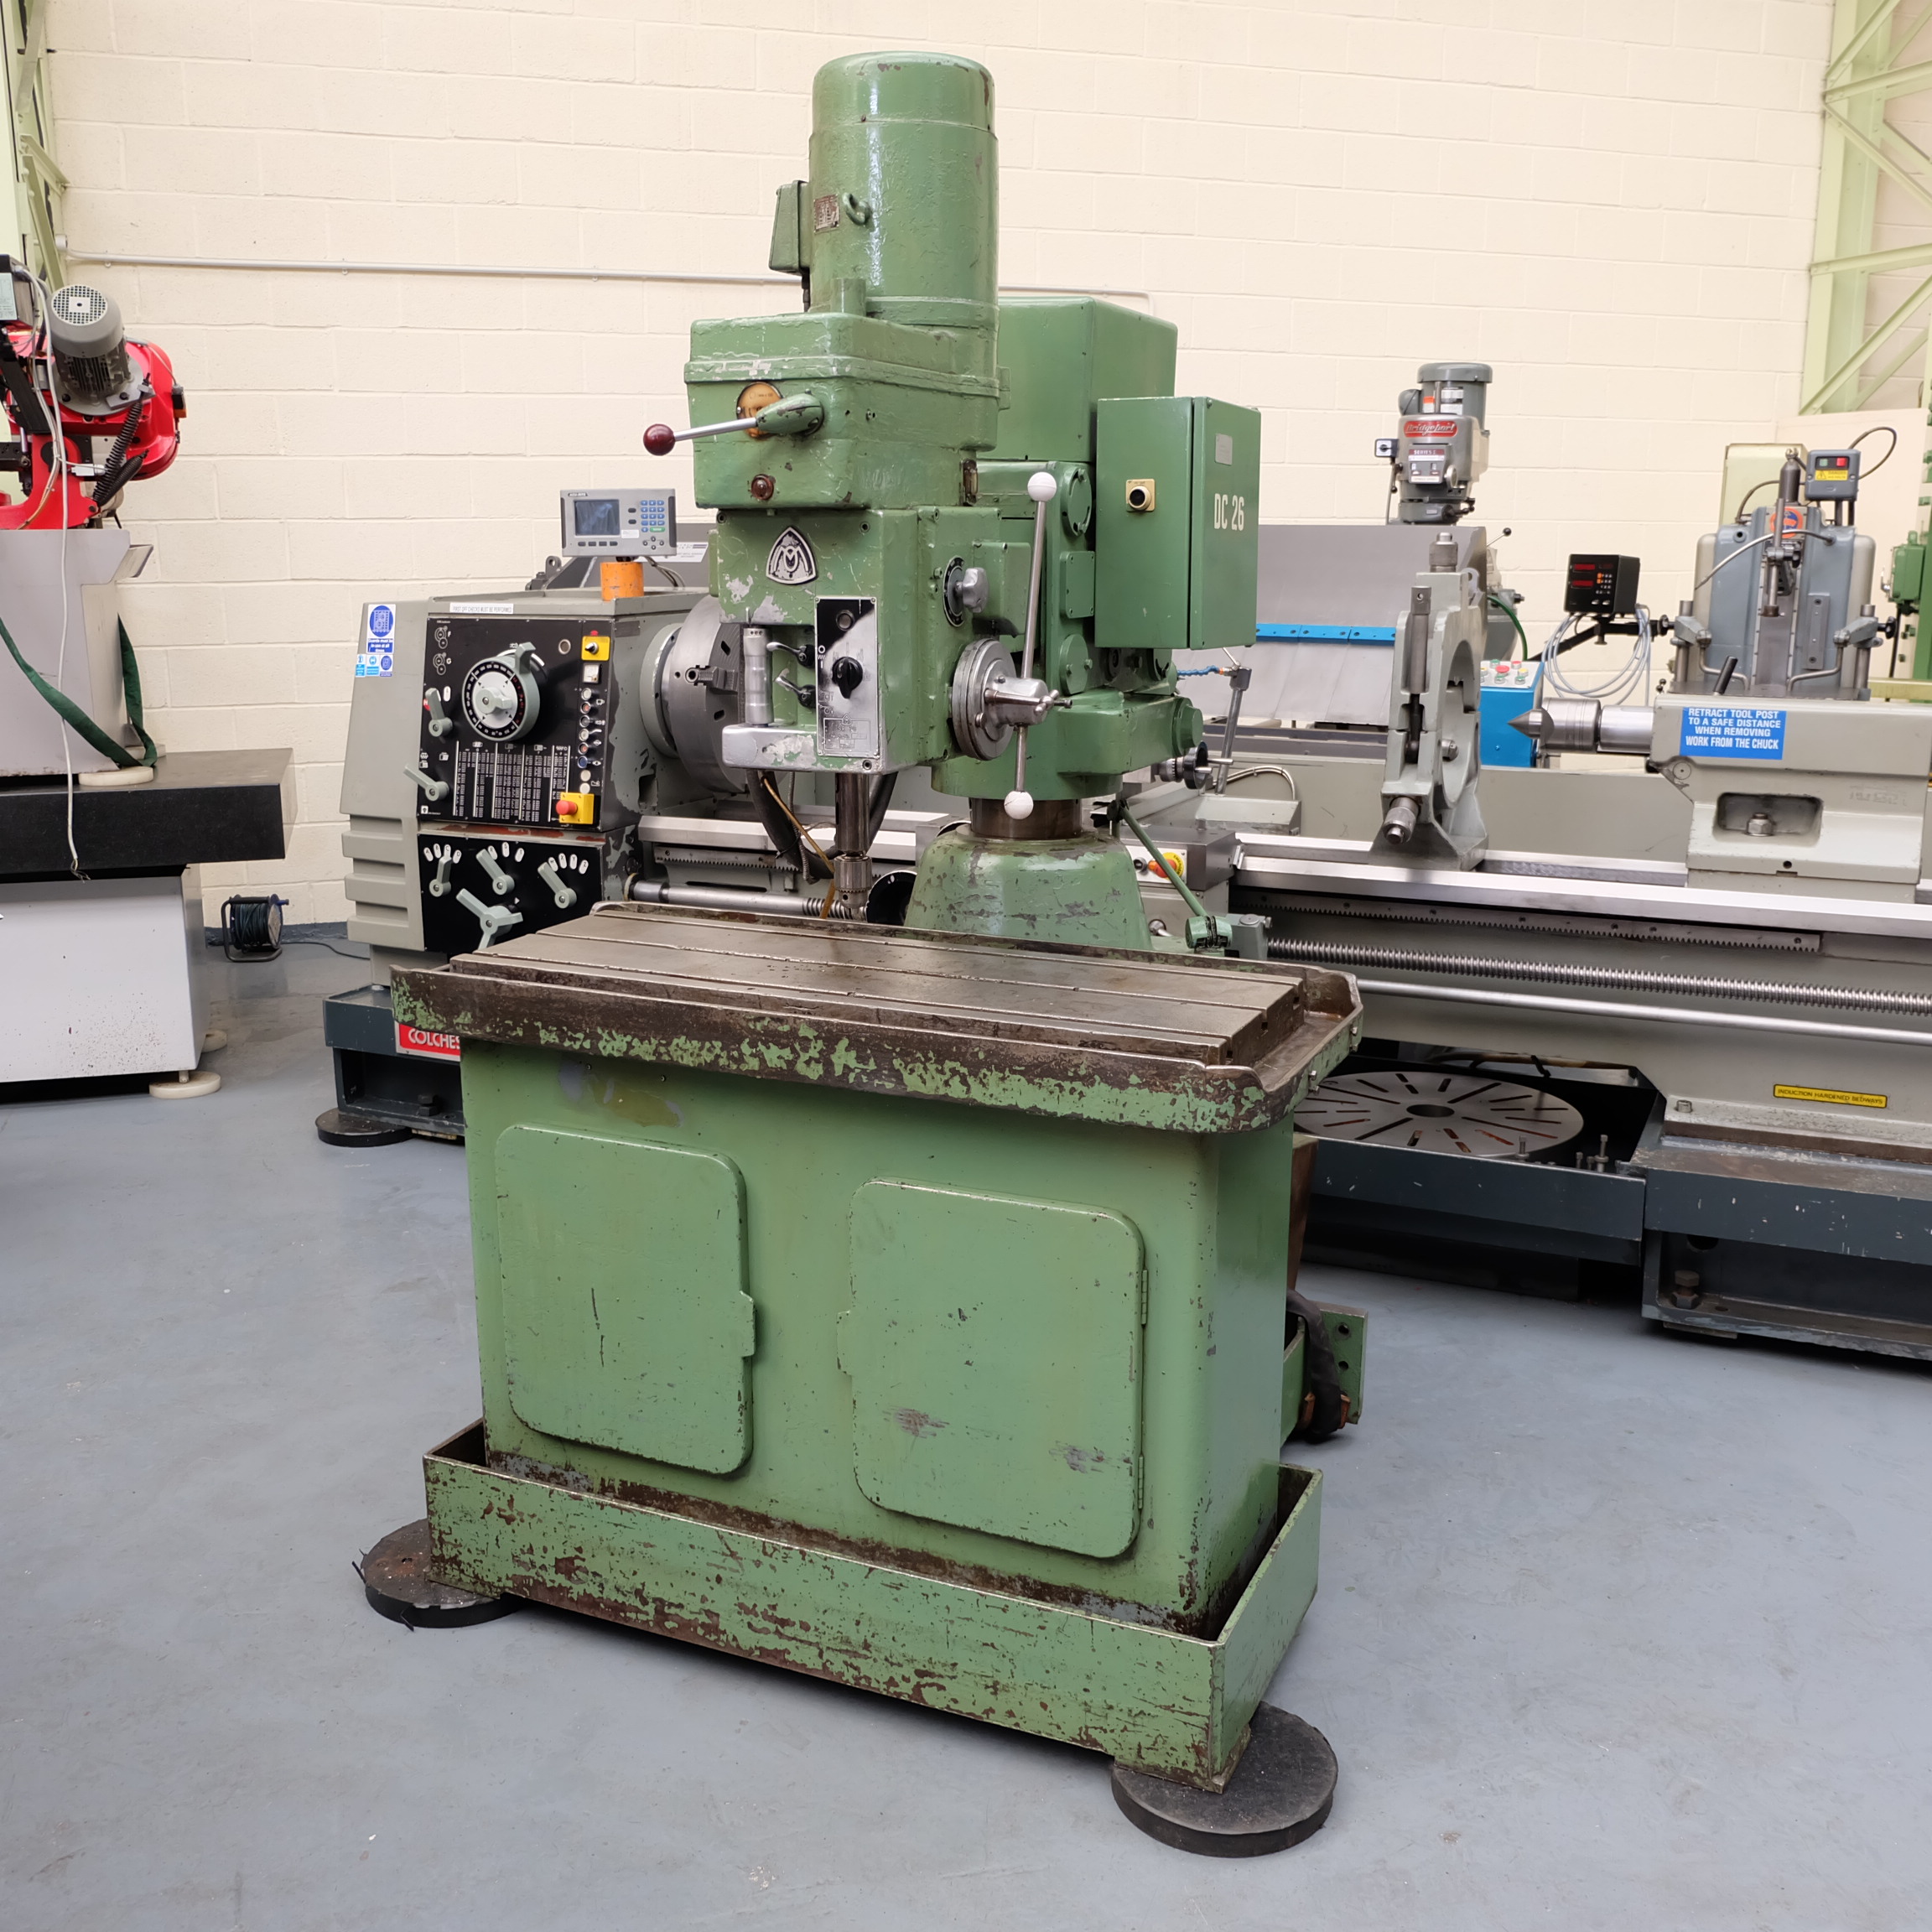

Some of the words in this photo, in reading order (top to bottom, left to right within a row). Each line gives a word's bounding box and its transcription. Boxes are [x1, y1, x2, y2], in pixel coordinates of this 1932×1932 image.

[1214, 493, 1228, 529] DC
[1232, 495, 1244, 531] 26
[1688, 708, 1727, 718] RETRACT
[1730, 709, 1753, 719] TOOL
[1755, 710, 1779, 719] POST
[1688, 717, 1701, 725] TO
[1711, 718, 1733, 727] SAFE
[1737, 719, 1781, 729] DISTANCE
[1695, 726, 1722, 735] WHEN
[1723, 727, 1771, 737] REMOVING
[1685, 735, 1709, 746] WORK
[1711, 736, 1732, 748] FROM
[1735, 738, 1750, 748] THE
[1752, 739, 1779, 750] CHUCK
[1778, 1088, 1813, 1098] INDUCTION
[1815, 1092, 1850, 1102] HARDENED
[1852, 1095, 1883, 1105] BEDWAYS
